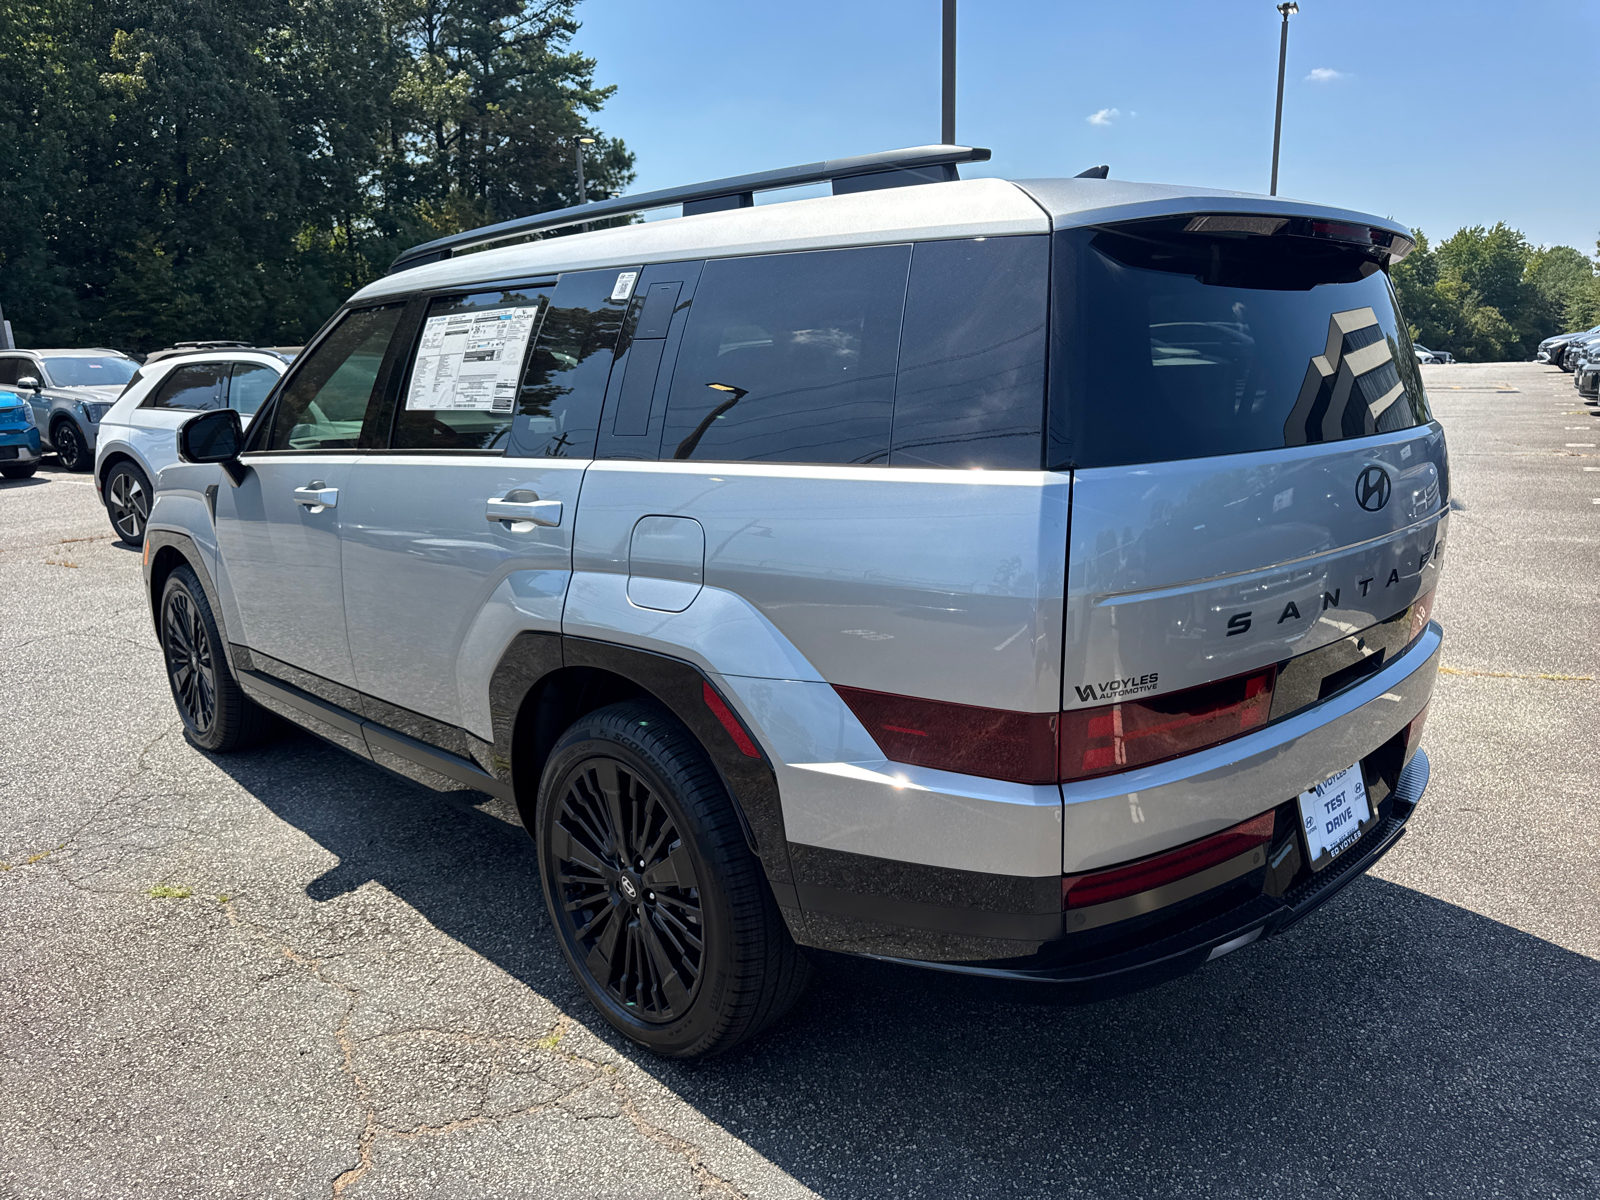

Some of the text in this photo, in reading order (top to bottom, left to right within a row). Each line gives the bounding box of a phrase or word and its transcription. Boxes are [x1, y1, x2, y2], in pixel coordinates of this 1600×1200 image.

[1098, 673, 1158, 692] VOYLES
[1099, 683, 1158, 700] AUTOMOTIVE
[1324, 790, 1346, 814] TEST
[1325, 806, 1353, 835] DRIVE
[1330, 846, 1339, 858] ED
[1340, 830, 1361, 850] VOYLES
